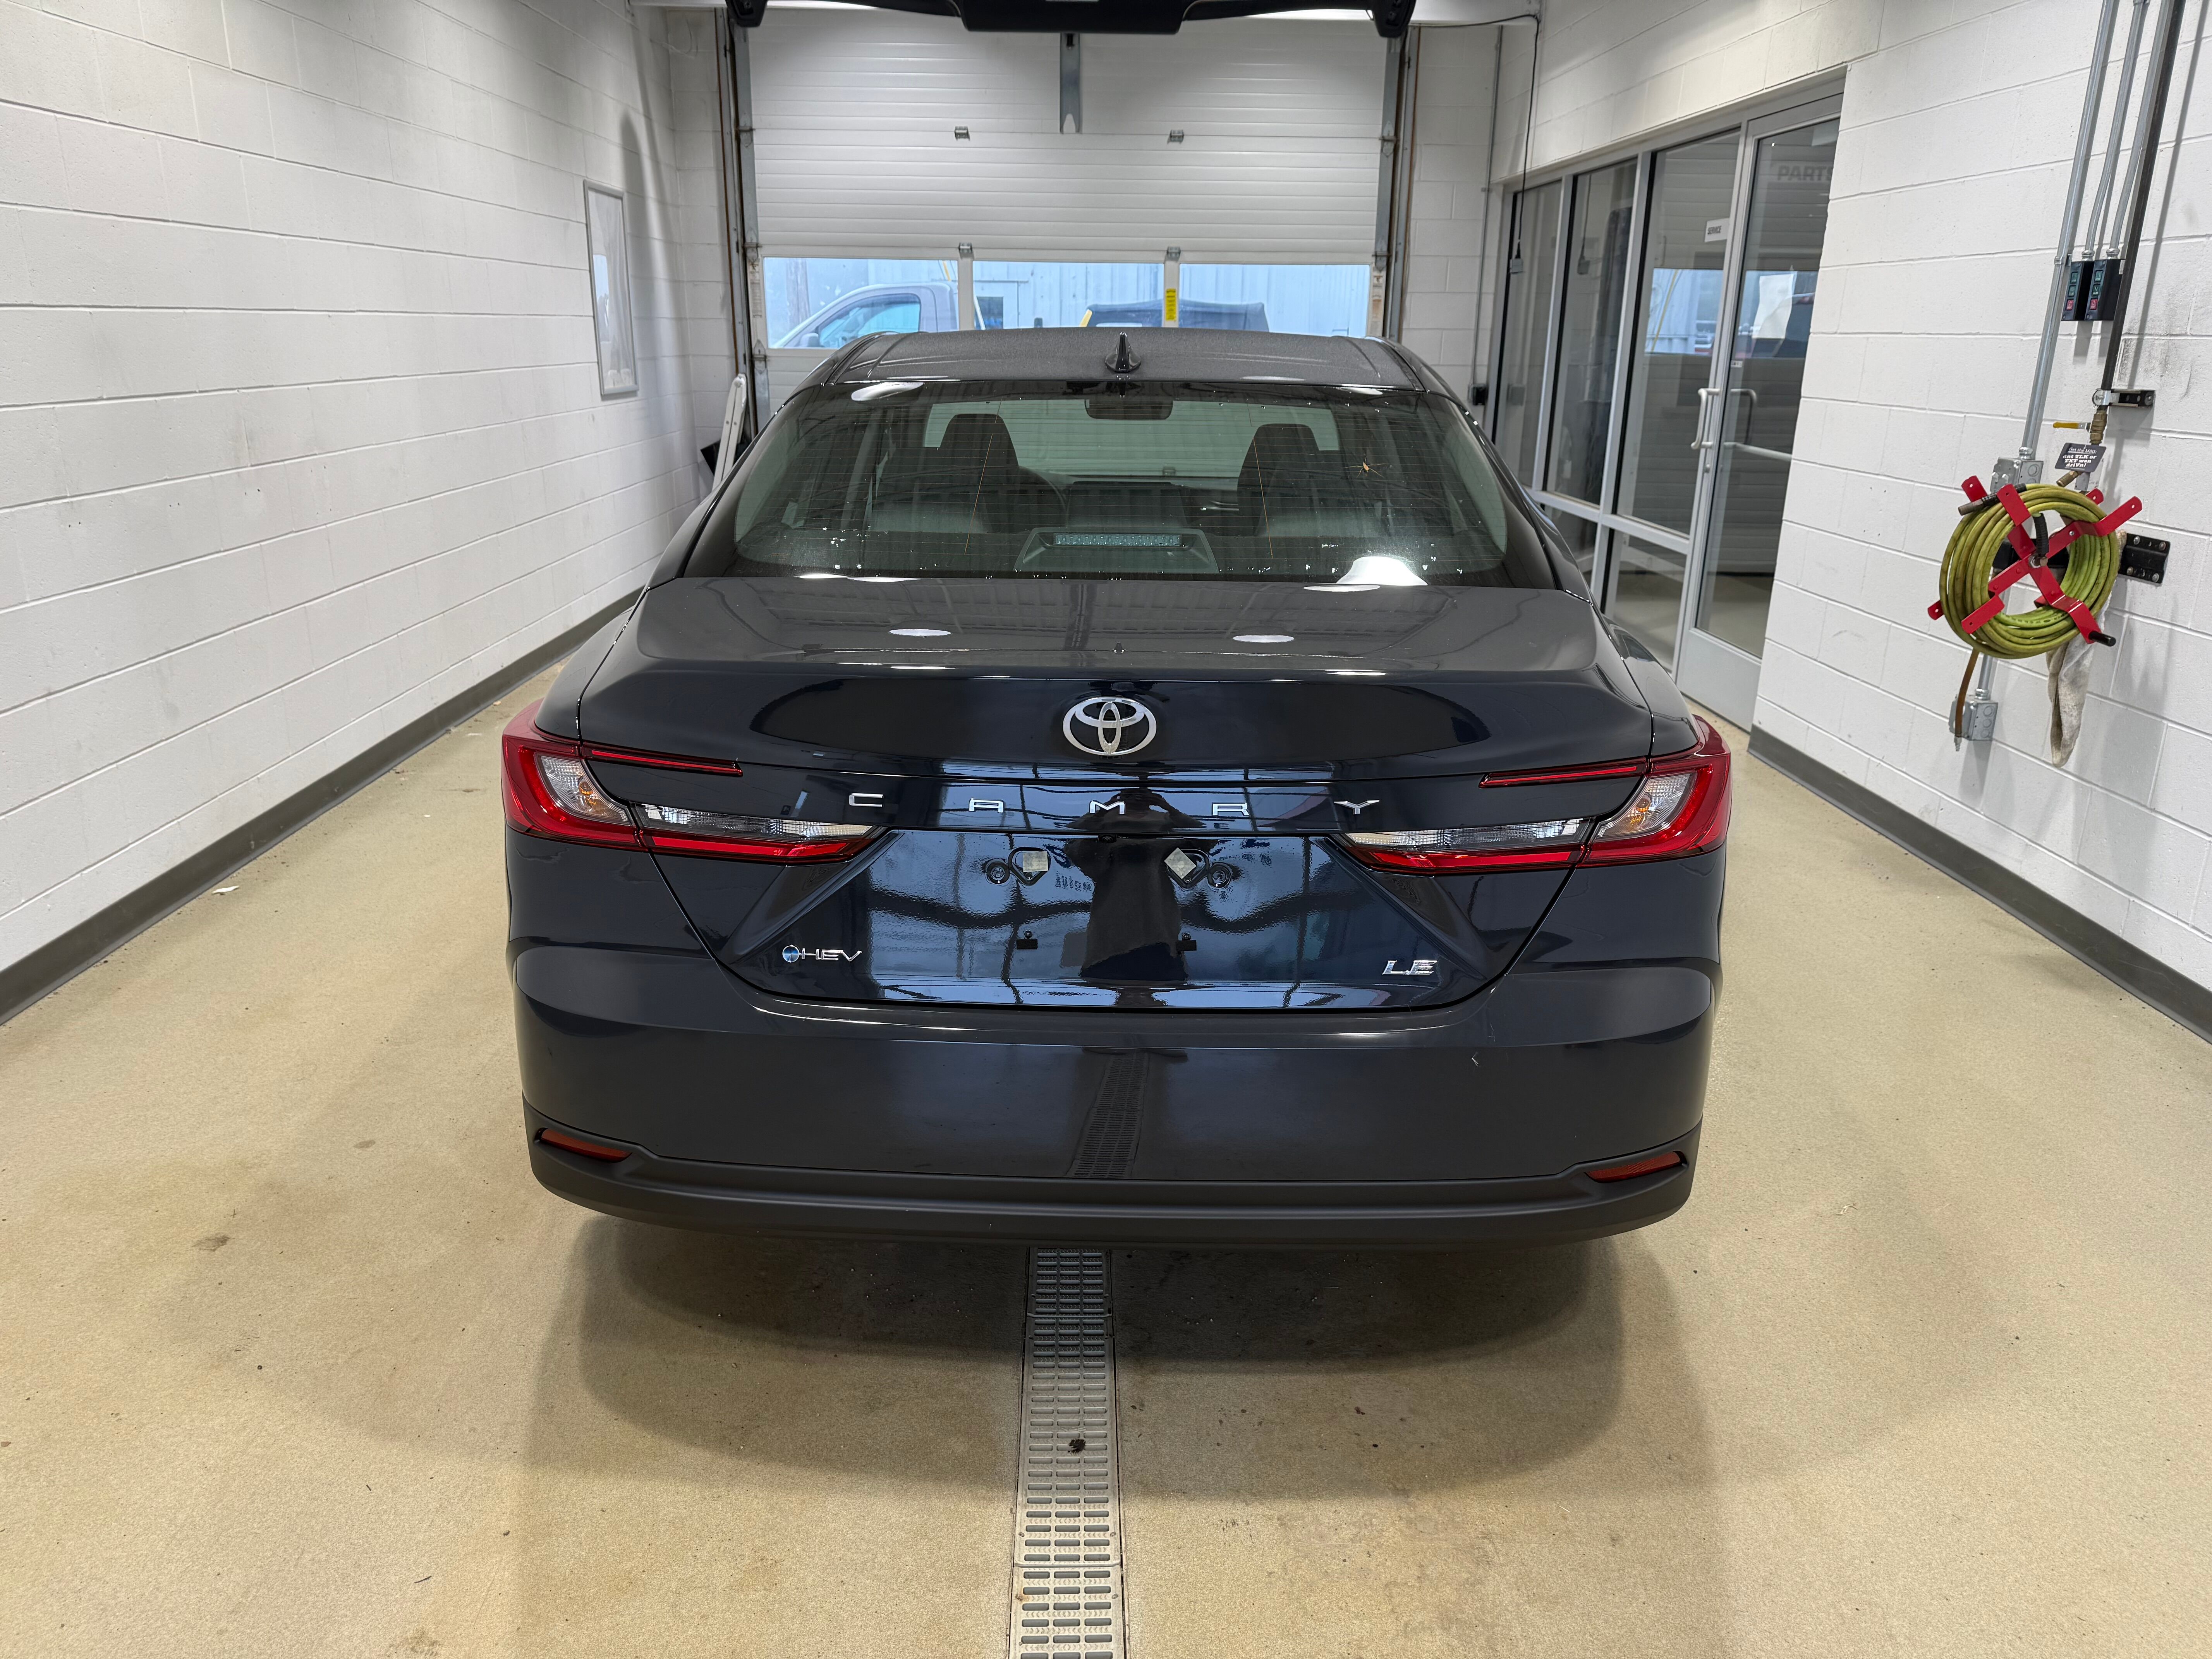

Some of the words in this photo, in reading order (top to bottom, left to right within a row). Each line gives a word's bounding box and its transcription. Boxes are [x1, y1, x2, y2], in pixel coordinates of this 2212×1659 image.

[848, 792, 1380, 816] CAMRY
[801, 948, 863, 962] HEV
[1382, 960, 1438, 975] LE
